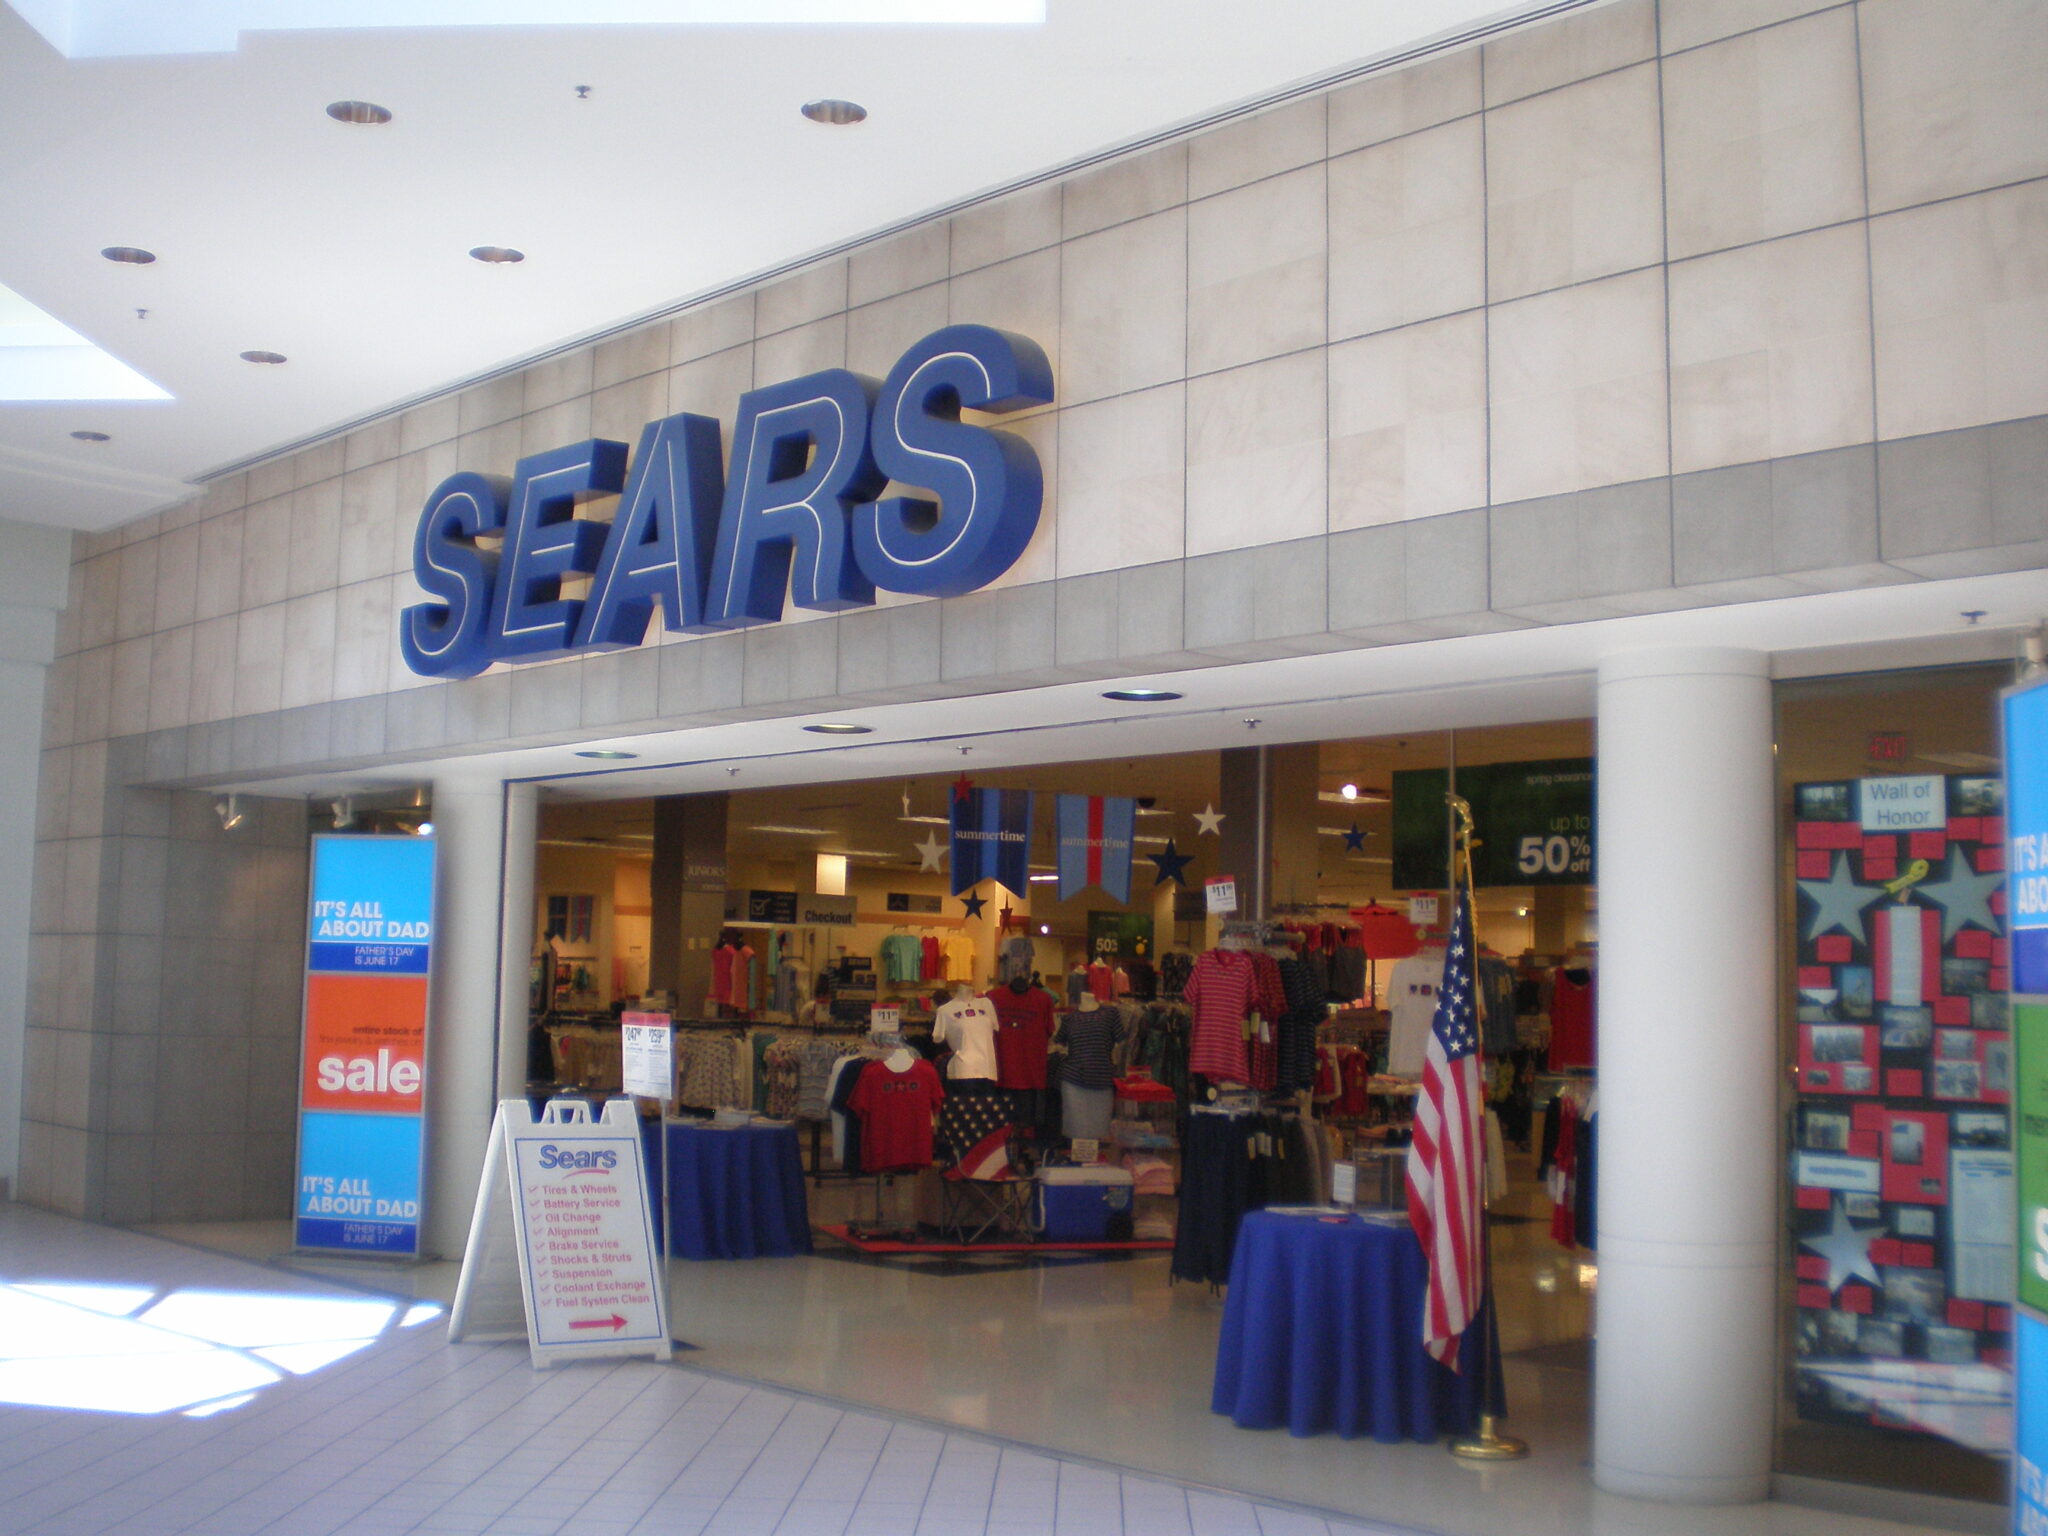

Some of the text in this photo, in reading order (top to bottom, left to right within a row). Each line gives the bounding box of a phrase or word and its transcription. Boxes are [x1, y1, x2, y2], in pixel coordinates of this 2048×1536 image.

[401, 323, 1054, 680] SEARS
[1870, 781, 1931, 800] Wall of
[1877, 808, 1931, 825] Honor
[1550, 814, 1591, 833] up to
[955, 830, 1026, 842] summertime
[1061, 837, 1129, 849] summertime
[1570, 858, 1591, 872] off
[315, 901, 383, 919] IT'S ALL
[805, 910, 853, 924] Checkout
[318, 920, 430, 938] ABOUT DAD
[355, 946, 415, 957] FATHER'S DAY
[354, 957, 399, 966] IS JUNE 17
[317, 1048, 420, 1094] sale
[539, 1144, 617, 1169] Sears
[302, 1176, 371, 1196] IT'S ALL
[542, 1184, 617, 1195] Tires & Wheels
[307, 1196, 417, 1218] ABOUT DAD
[544, 1198, 621, 1209] Battery Service
[545, 1213, 601, 1223] Oil Change
[547, 1227, 599, 1238] Alignment
[549, 1240, 619, 1250] Brake Service
[550, 1253, 632, 1265] Shocks & Struts
[552, 1269, 613, 1280] Suspension
[554, 1281, 646, 1293] Coolant Exchange
[556, 1294, 650, 1307] Fuel System Clean
